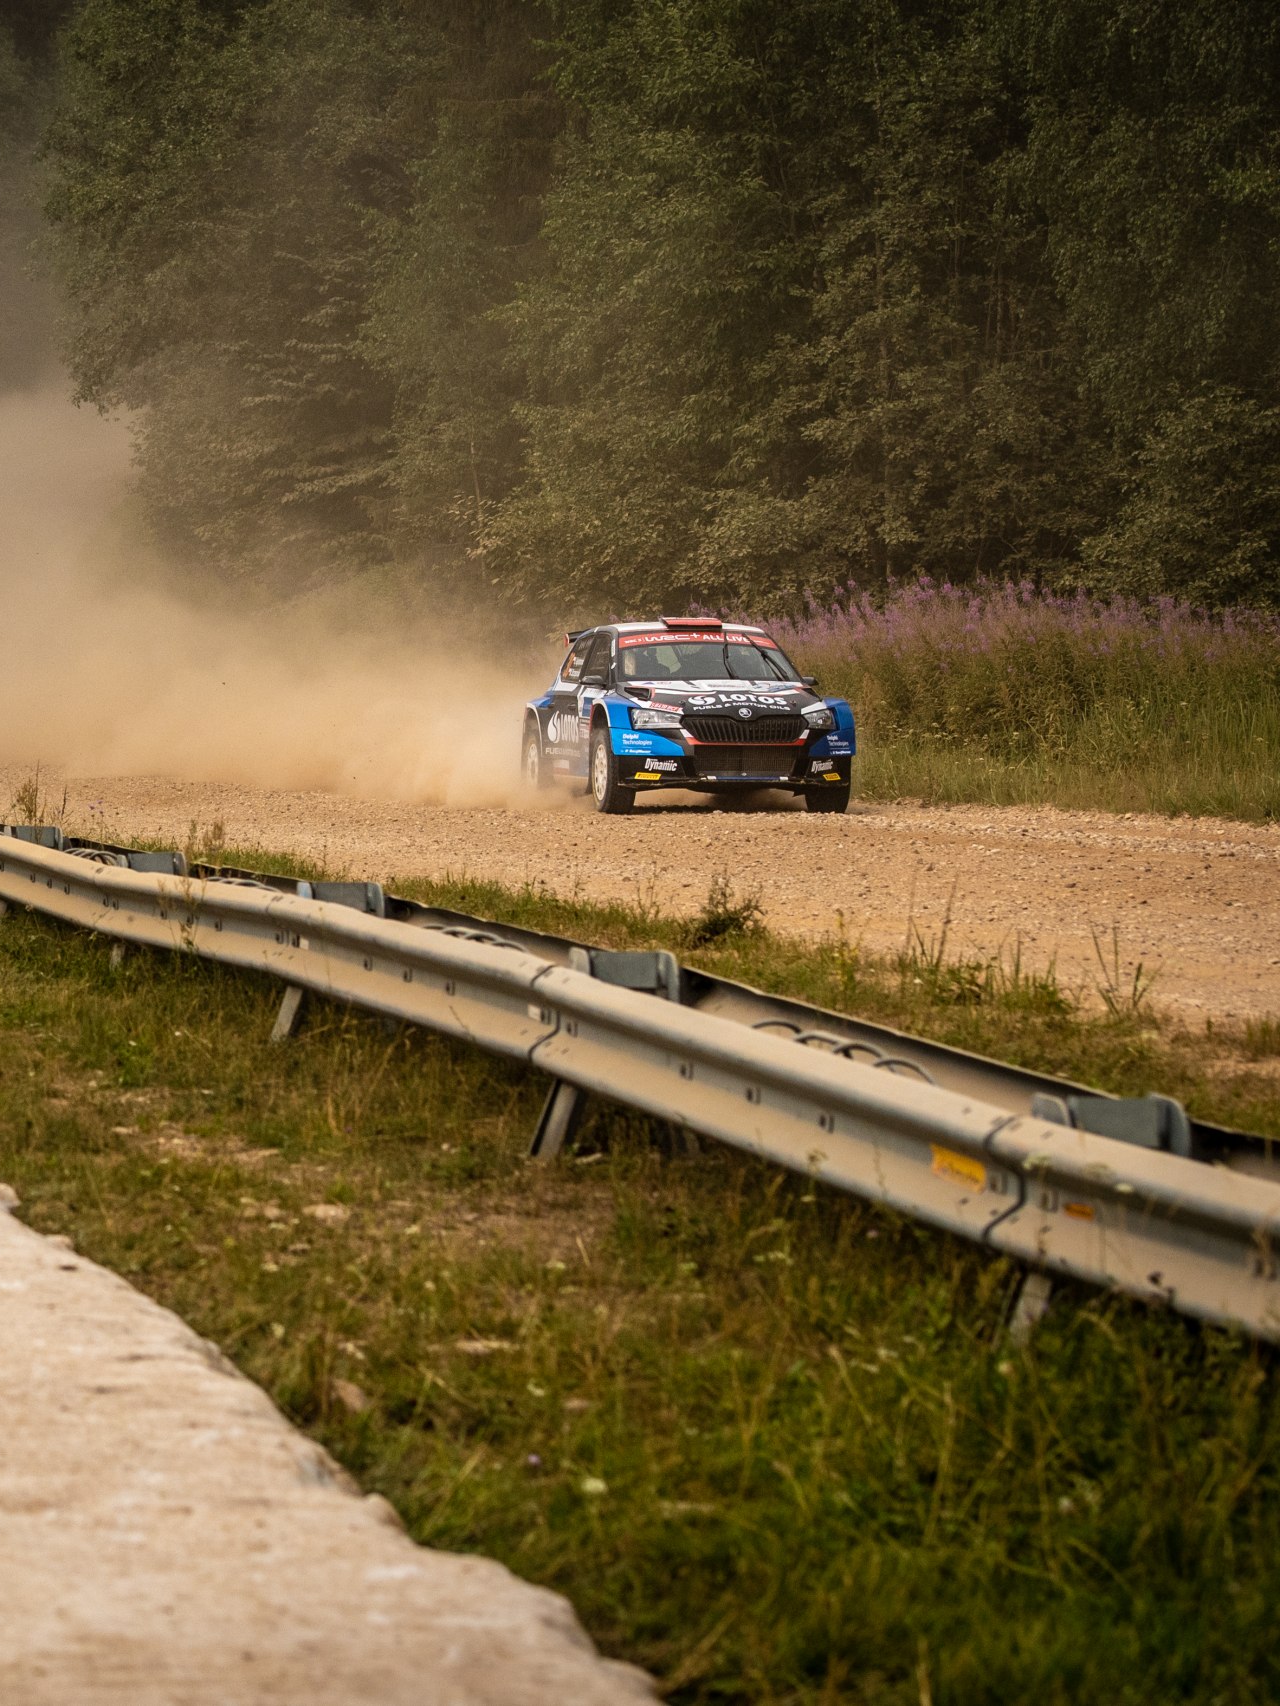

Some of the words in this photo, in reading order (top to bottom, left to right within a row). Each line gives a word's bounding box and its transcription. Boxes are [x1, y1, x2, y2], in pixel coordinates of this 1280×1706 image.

[726, 635, 750, 643] LIVE
[719, 694, 788, 706] LOTOS
[561, 714, 579, 743] LOTOS
[644, 758, 678, 771] Dynamic
